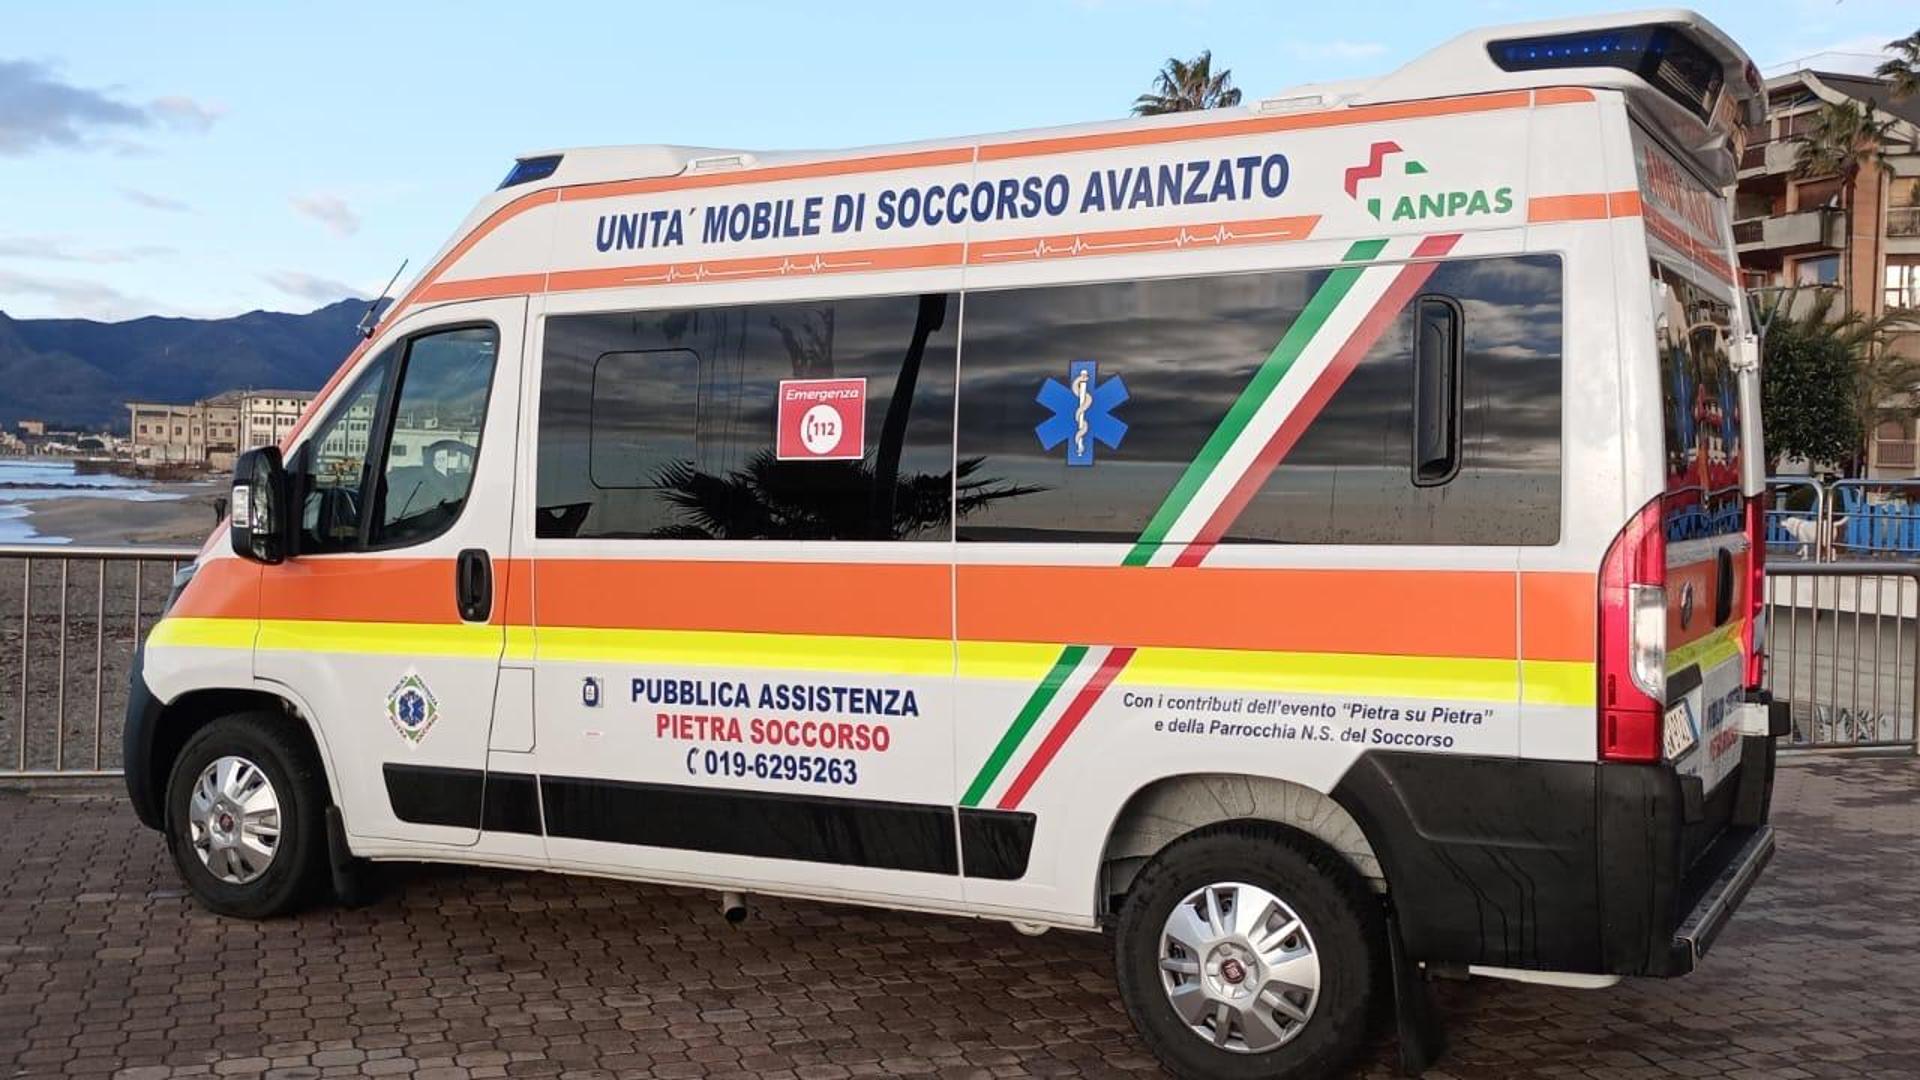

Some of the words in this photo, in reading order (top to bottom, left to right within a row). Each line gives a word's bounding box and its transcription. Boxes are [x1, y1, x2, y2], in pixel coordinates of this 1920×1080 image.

[702, 196, 824, 244] MOBILE
[831, 193, 866, 234] DI
[875, 174, 1070, 231] SOCCORSO
[1079, 153, 1290, 214] AVANZATO
[1392, 187, 1513, 221] ANPAS
[785, 389, 859, 402] Emergenza
[813, 421, 836, 437] 112
[631, 678, 751, 709] PUBBLICA
[758, 684, 920, 718] ASSISTENZA
[1123, 692, 1154, 709] Con
[1157, 694, 1164, 709] i
[1166, 696, 1243, 713] contributi
[1246, 698, 1337, 718] dell'evento
[1404, 708, 1427, 723] su
[656, 713, 743, 743] PIETRA
[749, 719, 891, 752] SOCCORSO
[1154, 719, 1164, 732] e
[1167, 718, 1205, 735] della
[1209, 719, 1297, 740] Parrocchia
[1301, 725, 1335, 742] N.S.
[1340, 727, 1367, 743] del
[1371, 728, 1455, 748] Soccorso
[704, 749, 858, 786] 019-6295263
